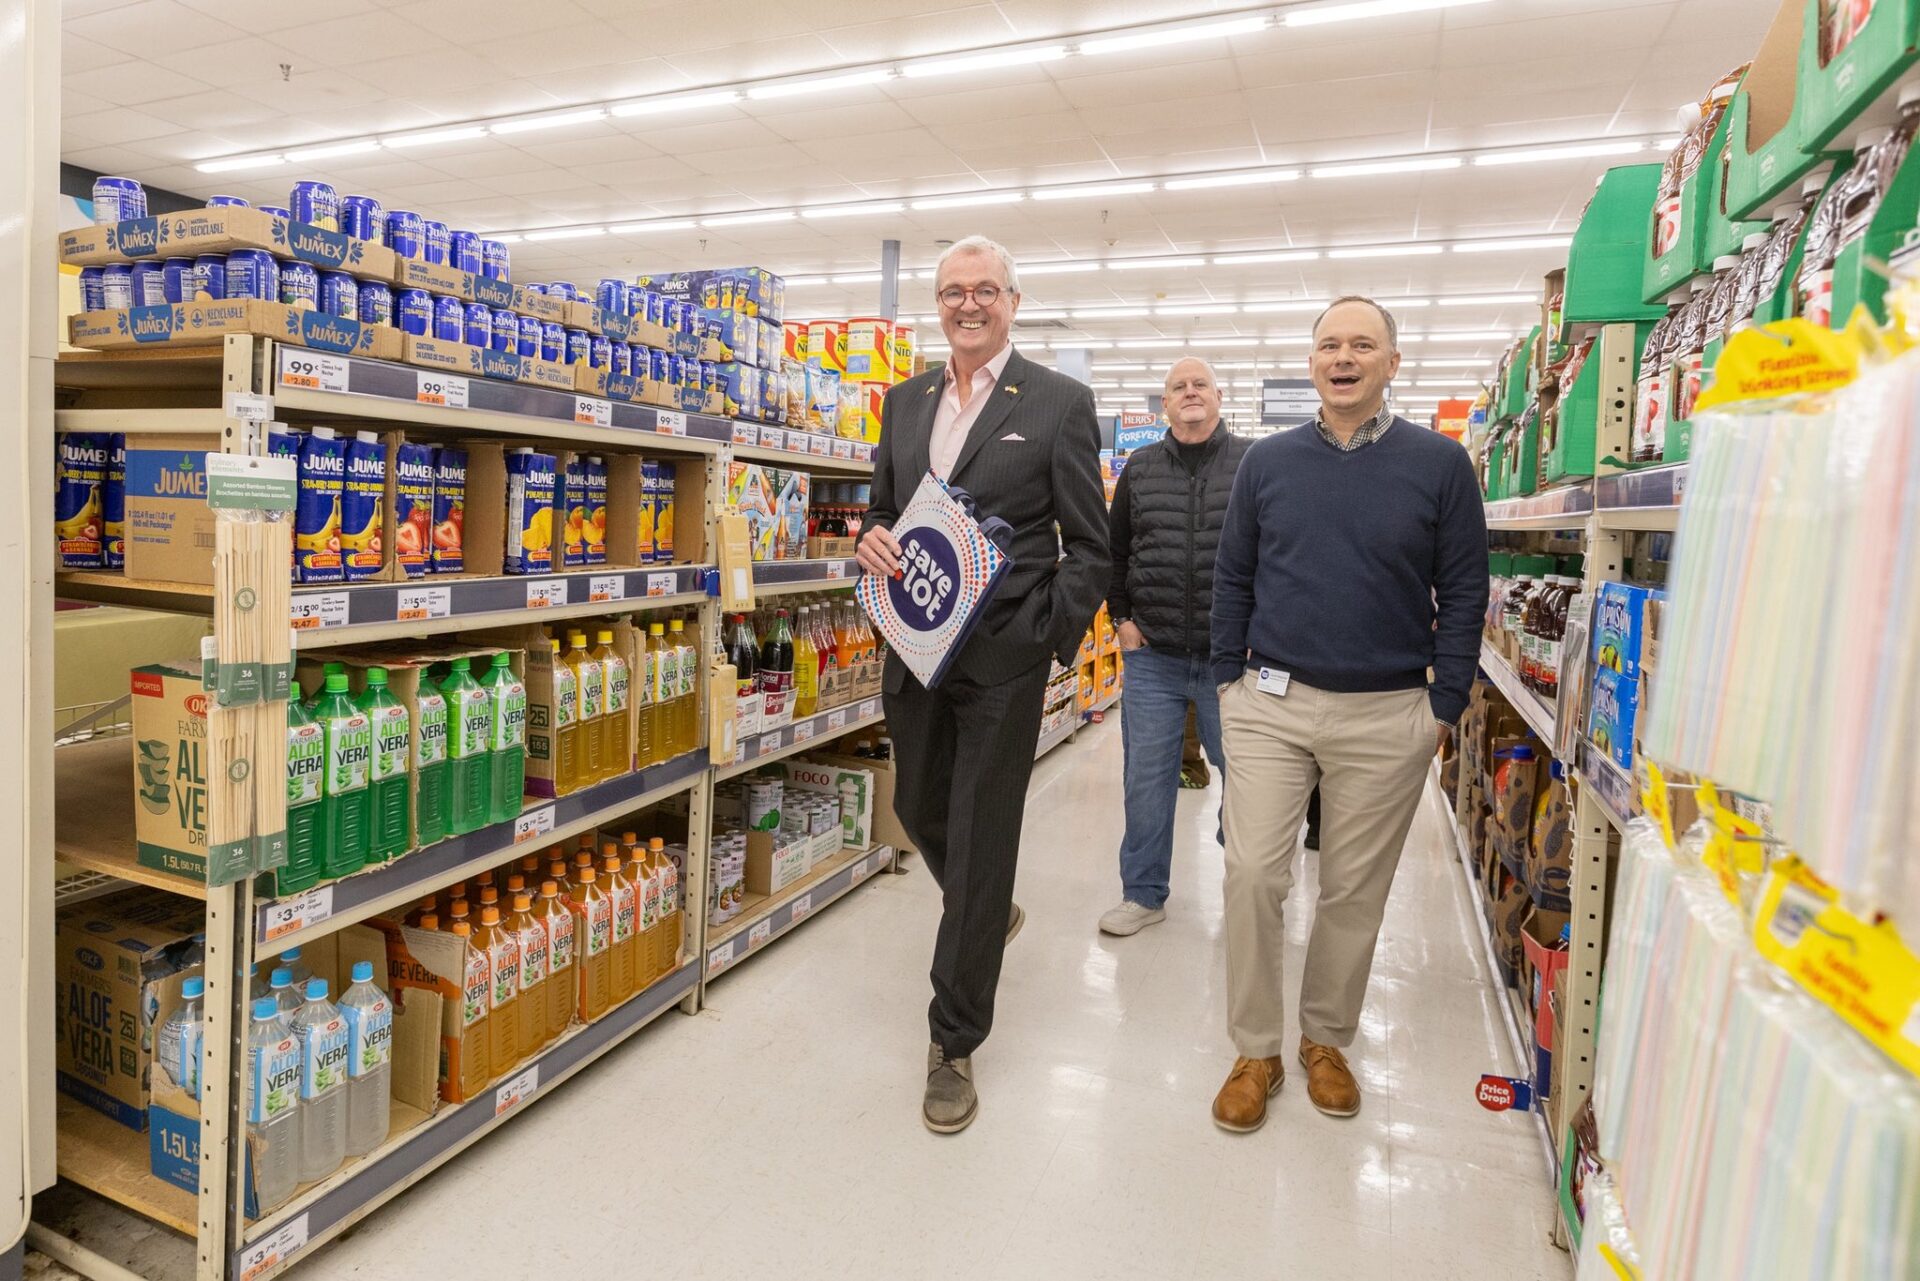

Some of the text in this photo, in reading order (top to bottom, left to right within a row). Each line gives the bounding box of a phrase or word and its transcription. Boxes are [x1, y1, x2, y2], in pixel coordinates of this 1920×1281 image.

[191, 222, 224, 237] RECYCLABLE
[120, 229, 155, 248] JUMEX
[294, 234, 342, 260] JUMEX
[661, 279, 689, 291] JUMEX
[477, 287, 509, 306] JUMEX
[207, 307, 244, 320] RECYCLABLE
[134, 317, 170, 335] JUMEX
[306, 323, 354, 347] JUMEX
[485, 361, 517, 377] JUMEX
[609, 382, 633, 395] JUMEX
[684, 395, 704, 407] JUMEX
[1118, 430, 1158, 444] FOREVER
[154, 467, 208, 497] JUME
[222, 481, 246, 490] Assorted
[246, 483, 266, 491] Bamboo
[215, 489, 244, 498] Brochettes
[905, 538, 953, 599] save
[241, 669, 253, 679] 36
[278, 671, 287, 679] 75
[612, 667, 628, 681] ALOE
[663, 661, 678, 672] ALOE
[681, 665, 697, 678] VERA
[586, 672, 602, 685] ALOE
[661, 670, 678, 684] VERA
[134, 681, 161, 692] IMPORTED
[584, 683, 602, 700] VERA
[609, 679, 628, 693] VERA
[505, 695, 526, 713] ALOE
[560, 690, 577, 706] VERA
[192, 700, 208, 715] OK
[467, 702, 489, 718] ALOE
[421, 709, 447, 726] ALOE
[465, 715, 489, 733] VERA
[502, 709, 526, 726] VERA
[529, 709, 546, 727] 25
[382, 718, 409, 738] ALOE
[420, 724, 447, 742] VERA
[339, 729, 370, 750] ALOE
[377, 733, 409, 754] VERA
[288, 739, 322, 761] ALOE
[335, 745, 370, 766] VERA
[287, 758, 323, 778] VERA
[794, 769, 830, 786] FOCO
[174, 779, 208, 831] VE
[232, 847, 243, 857] 36
[272, 841, 282, 850] 75
[775, 847, 791, 860] FOCO
[162, 854, 180, 870] 1.5L
[661, 884, 678, 898] VERA
[618, 895, 635, 912] ALOE
[643, 895, 660, 912] VERA
[593, 908, 610, 924] ALOE
[616, 906, 635, 922] VERA
[554, 923, 573, 940] ALOE
[591, 918, 610, 936] VERA
[526, 935, 548, 955] ALOE
[552, 934, 573, 952] VERA
[497, 950, 519, 971] ALOE
[524, 948, 548, 967] VERA
[467, 968, 489, 989] ALOE
[495, 963, 519, 985] VERA
[465, 982, 489, 1003] VERA
[69, 982, 113, 1035] ALOE
[121, 1016, 135, 1040] 25
[366, 1012, 392, 1035] ALOE
[320, 1031, 348, 1054] ALOE
[362, 1024, 392, 1049] VERA
[68, 1020, 115, 1076] VERA
[269, 1049, 299, 1077] ALOE
[315, 1044, 348, 1070] VERA
[75, 1058, 108, 1087] COCONUT
[266, 1065, 301, 1093] VERA
[1481, 1083, 1509, 1095] Price
[1480, 1091, 1511, 1105] Drop!
[160, 1127, 193, 1164] 1.5L
